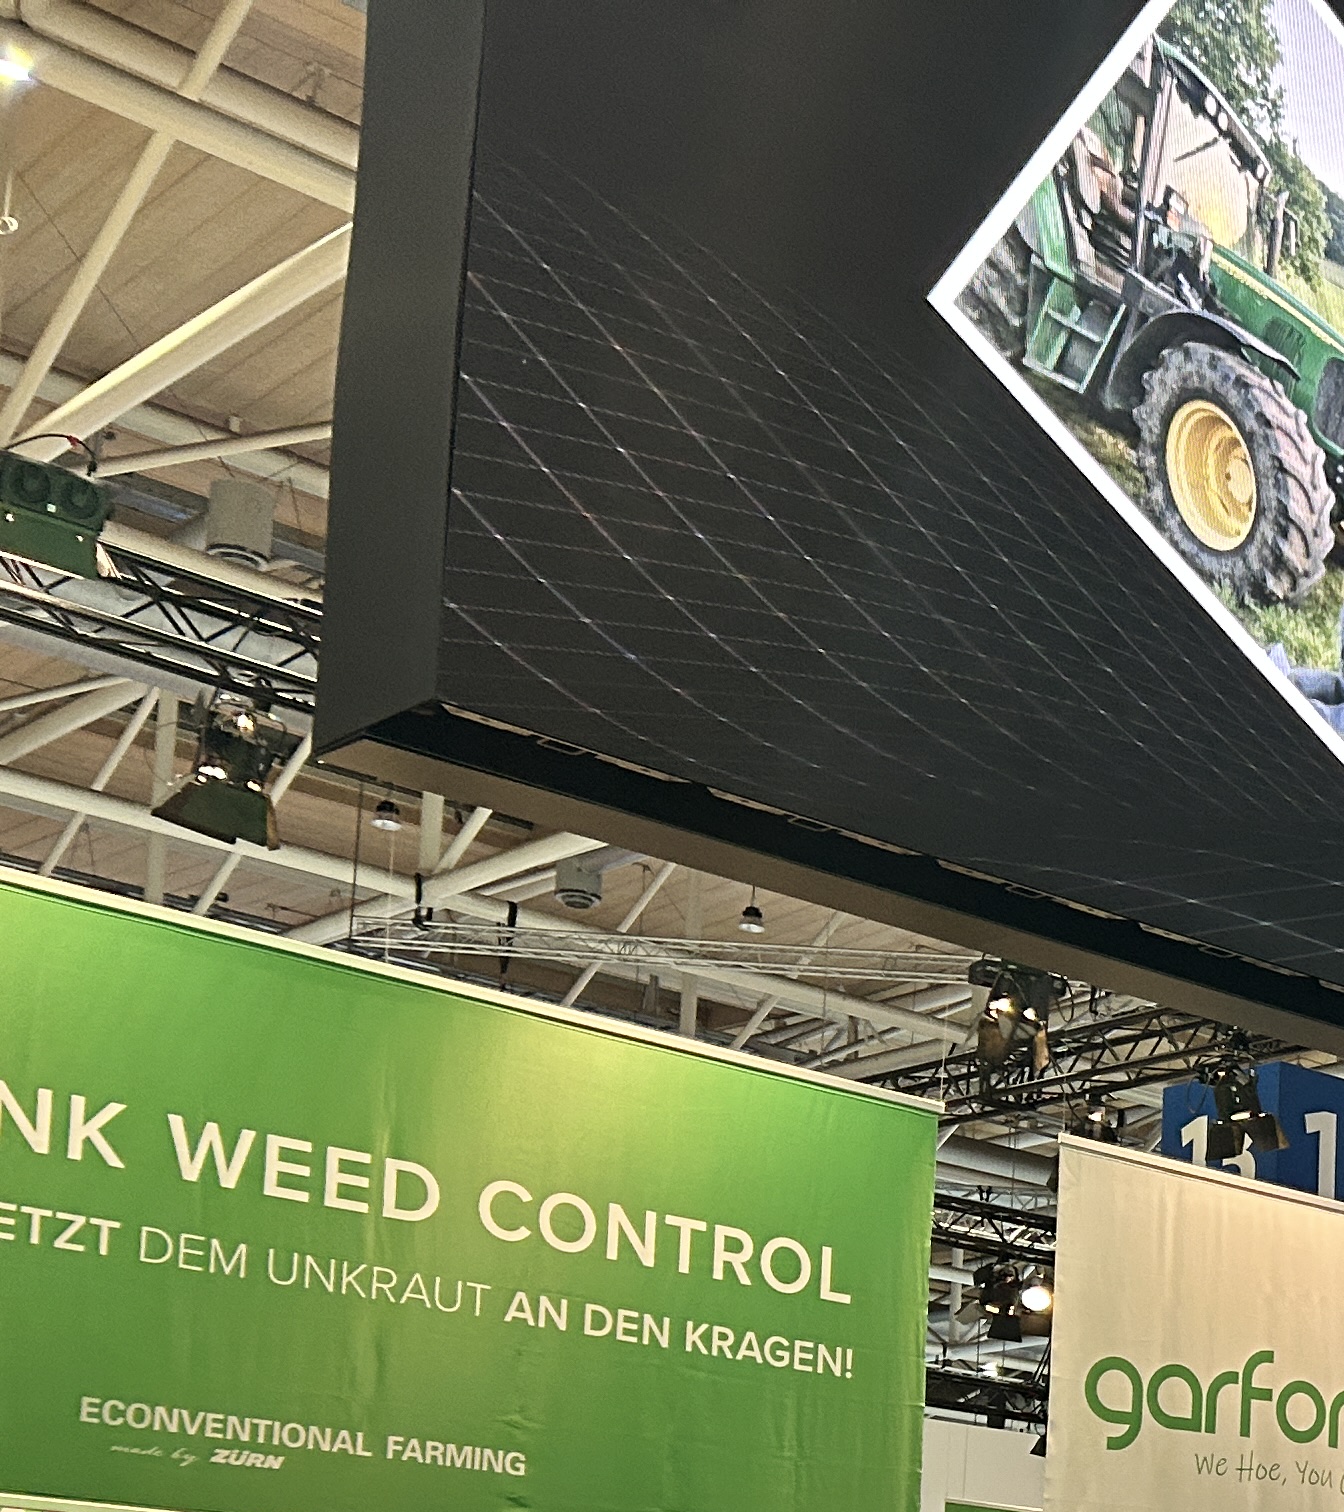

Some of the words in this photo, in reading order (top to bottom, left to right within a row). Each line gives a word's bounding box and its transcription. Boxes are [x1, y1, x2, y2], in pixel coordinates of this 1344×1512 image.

[167, 1113, 441, 1223] WEED
[479, 1180, 852, 1305] CONTROL
[140, 1226, 248, 1279] DEM
[267, 1251, 492, 1319] UNKRAUT
[505, 1291, 569, 1332] AN
[584, 1305, 671, 1350] DEN
[684, 1322, 856, 1379] KRAGEN!
[79, 1396, 373, 1457] ECONVENTIONAL
[386, 1435, 526, 1476] FARMING
[170, 1448, 199, 1467] by
[208, 1448, 286, 1470] ZÜRN
[1195, 1453, 1228, 1478] We
[1235, 1450, 1287, 1486] Hoe,
[1295, 1461, 1332, 1489] You
